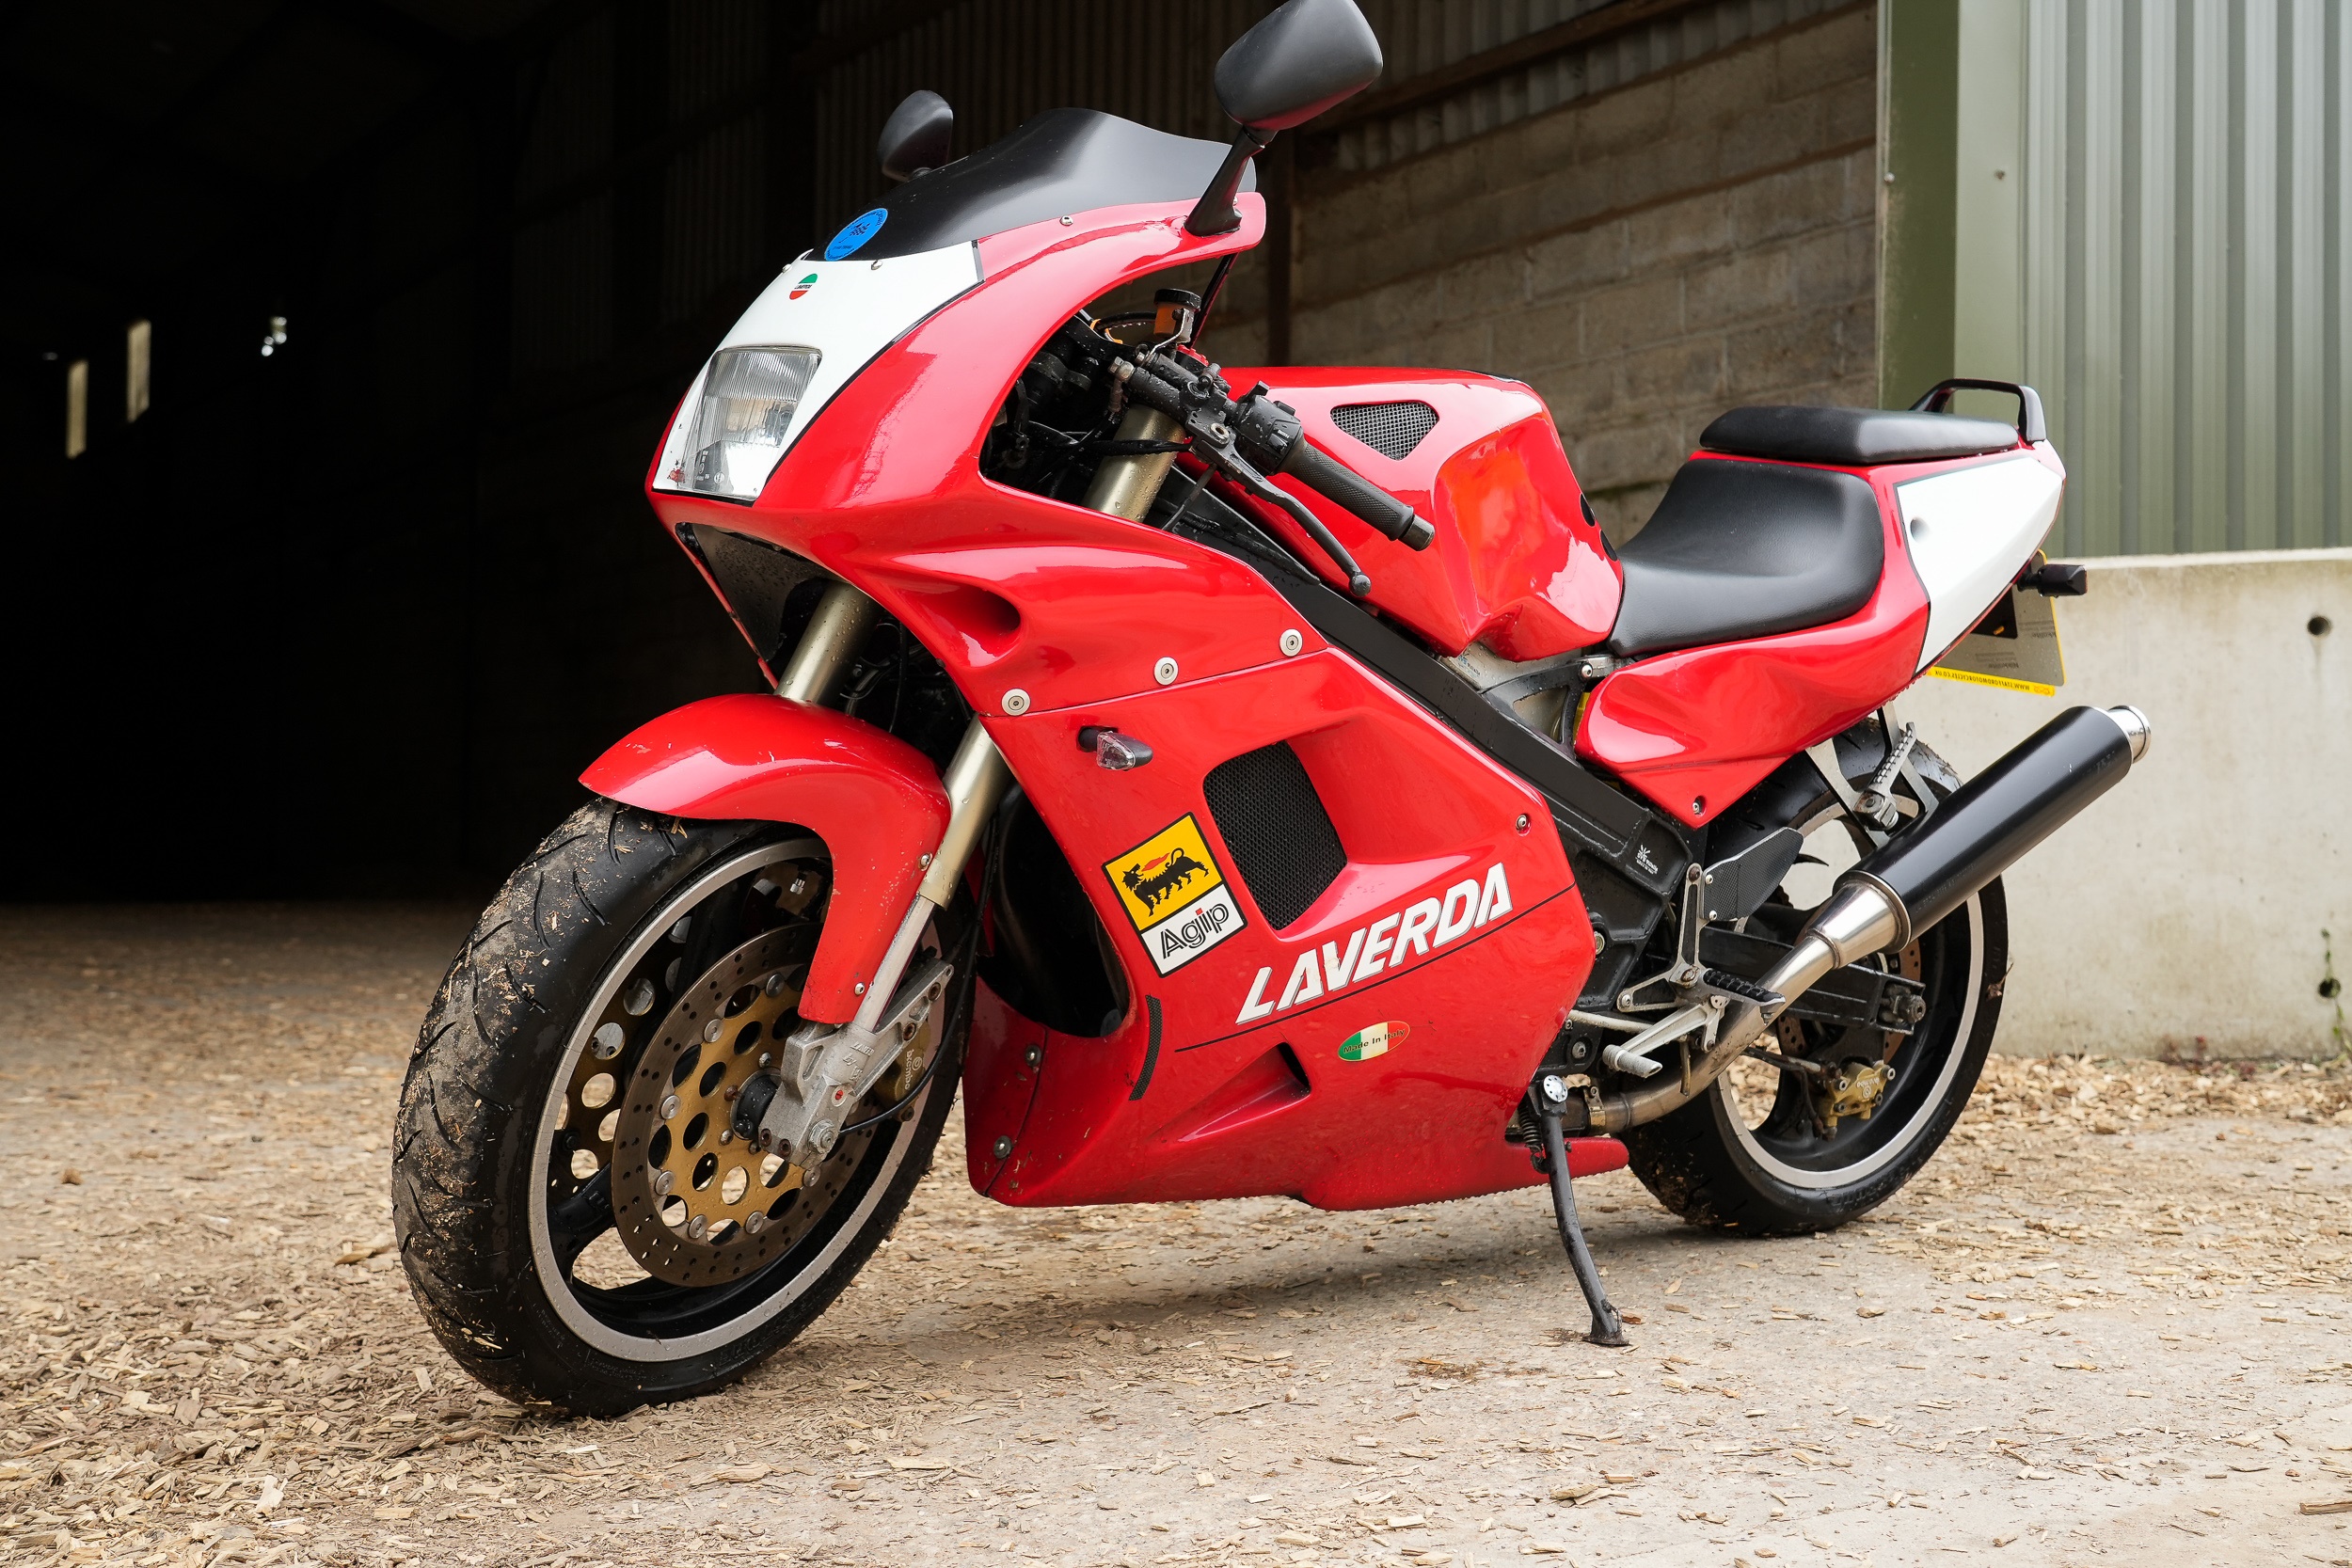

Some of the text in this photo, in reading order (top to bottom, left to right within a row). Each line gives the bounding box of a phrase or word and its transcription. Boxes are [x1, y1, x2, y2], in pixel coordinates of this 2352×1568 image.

[1159, 903, 1230, 959] Agip
[1235, 862, 1513, 1025] LAVERDA
[1343, 1040, 1369, 1053] Made
[1384, 1029, 1406, 1040] Italy
[904, 1049, 914, 1090] brembo
